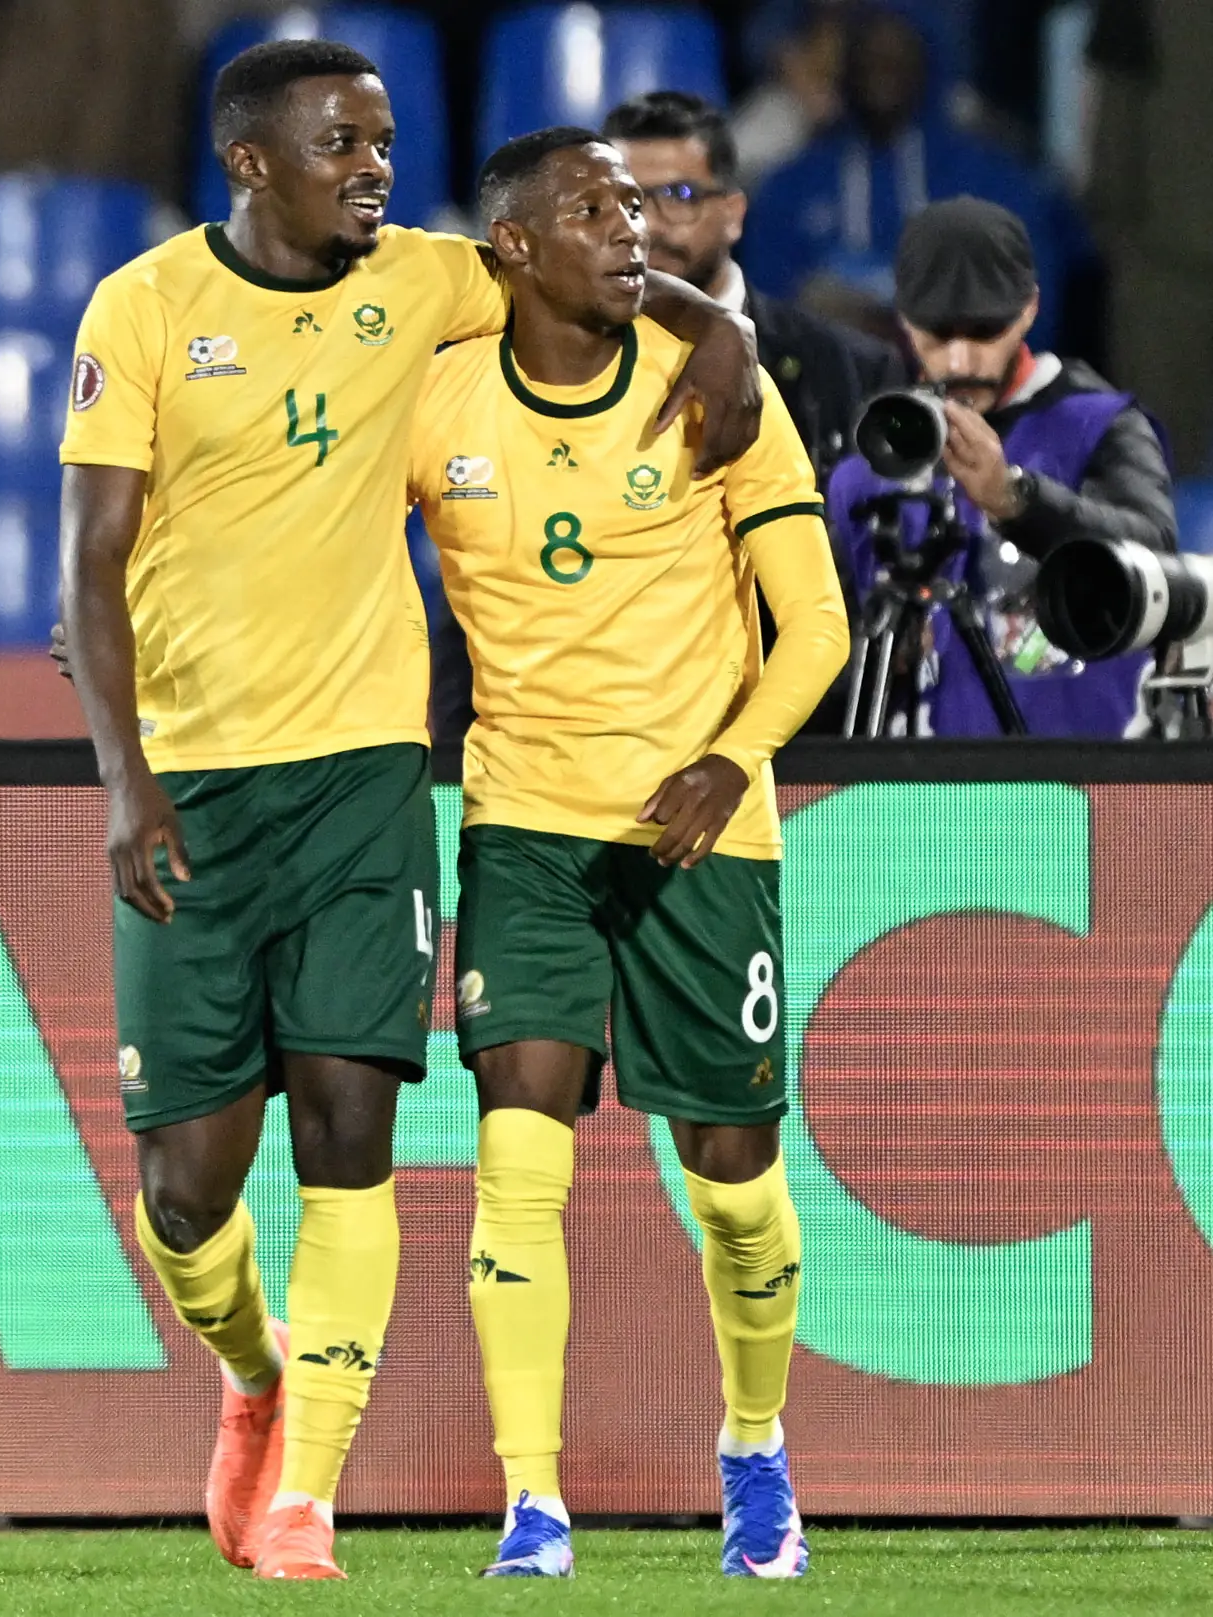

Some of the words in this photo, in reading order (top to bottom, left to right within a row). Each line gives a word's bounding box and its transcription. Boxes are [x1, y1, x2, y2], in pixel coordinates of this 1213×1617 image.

[284, 388, 340, 467] 4
[540, 511, 594, 585] 8
[740, 950, 778, 1044] 8
